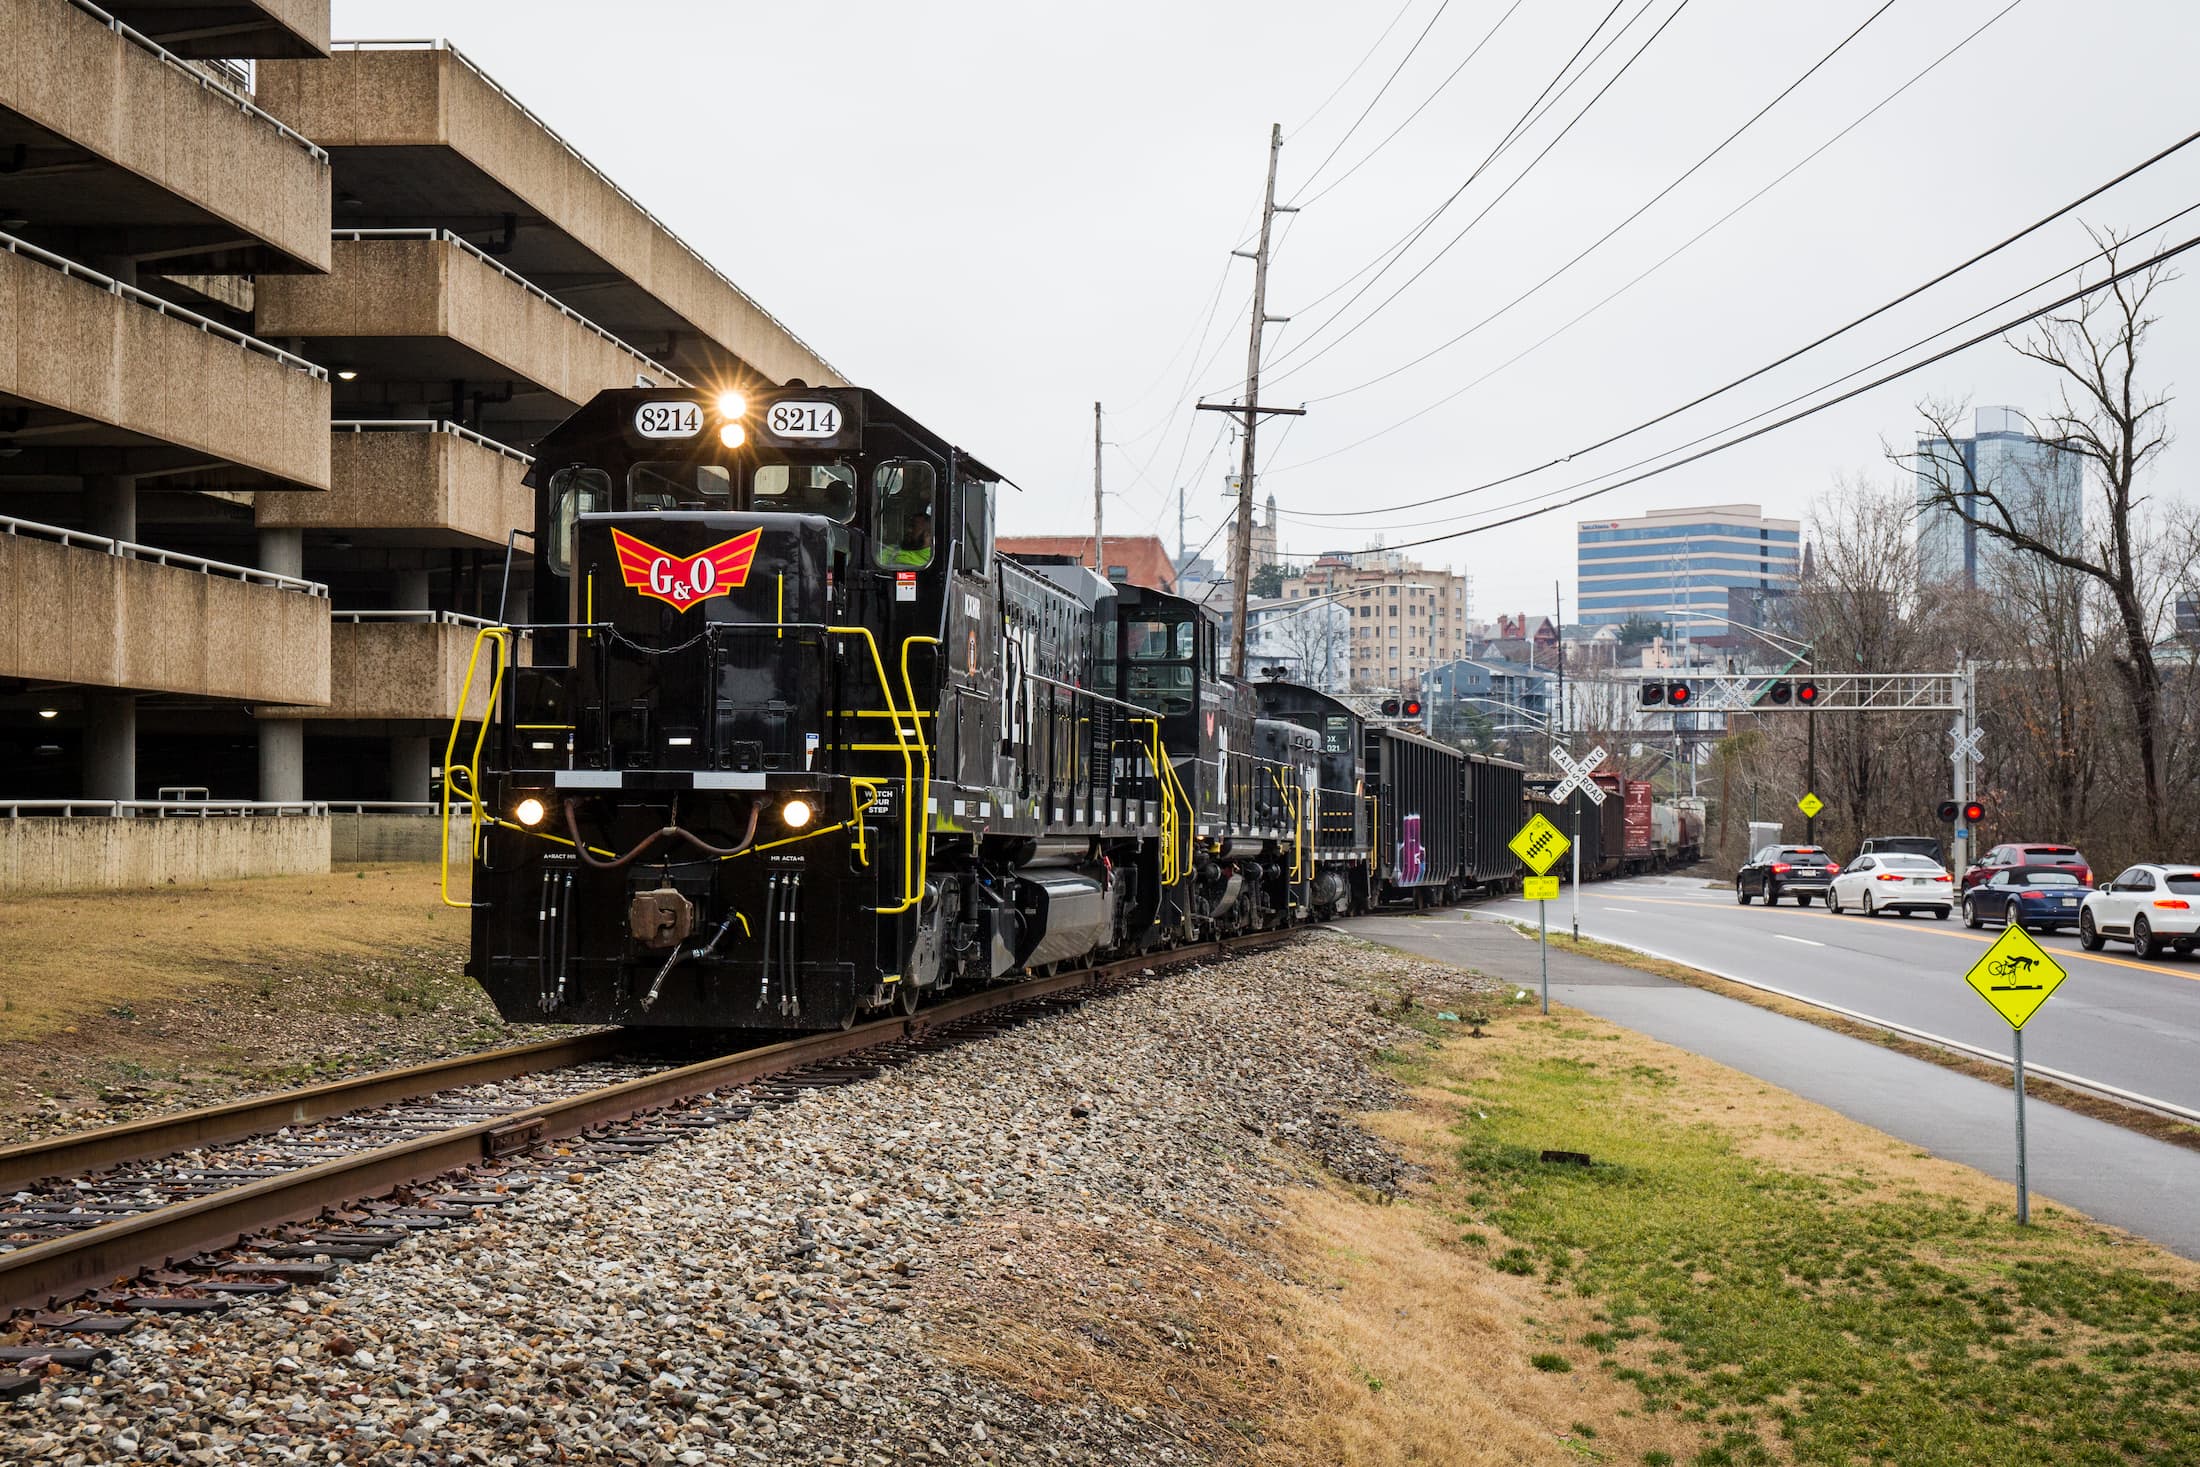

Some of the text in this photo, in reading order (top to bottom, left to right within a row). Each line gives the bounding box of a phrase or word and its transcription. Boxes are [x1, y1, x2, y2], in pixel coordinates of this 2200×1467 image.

[641, 407, 698, 432] 8214
[773, 407, 836, 432] 8214
[650, 557, 716, 600] G&O
[1552, 748, 1575, 773] RAIL
[1580, 777, 1604, 802] ROAD
[1552, 749, 1604, 801] CROSSING
[864, 790, 893, 798] WTCH
[868, 806, 889, 814] STEP
